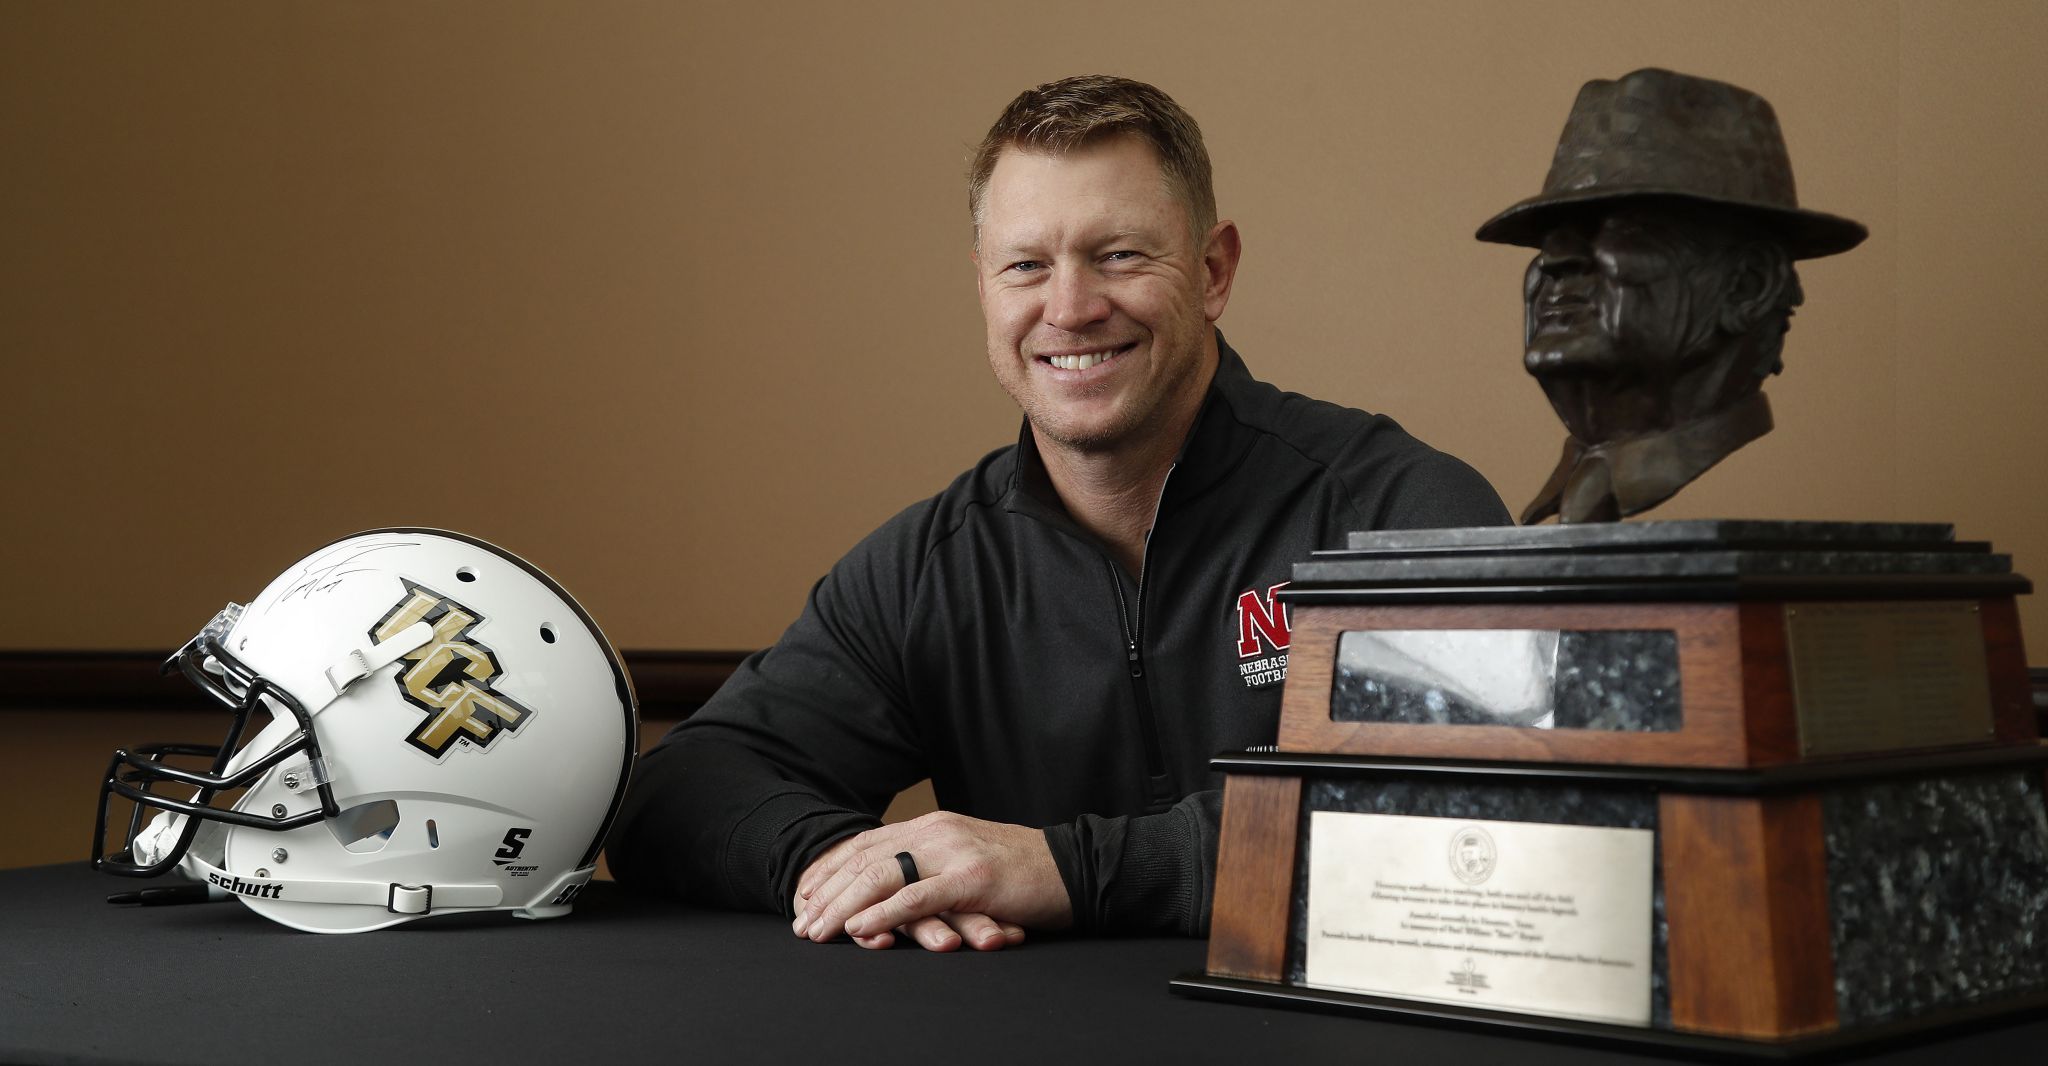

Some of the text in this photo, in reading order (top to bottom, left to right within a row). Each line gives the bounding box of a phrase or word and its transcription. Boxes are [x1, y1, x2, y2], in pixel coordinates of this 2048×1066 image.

[1237, 580, 1293, 658] N
[494, 827, 532, 858] S
[208, 872, 284, 899] schutt
